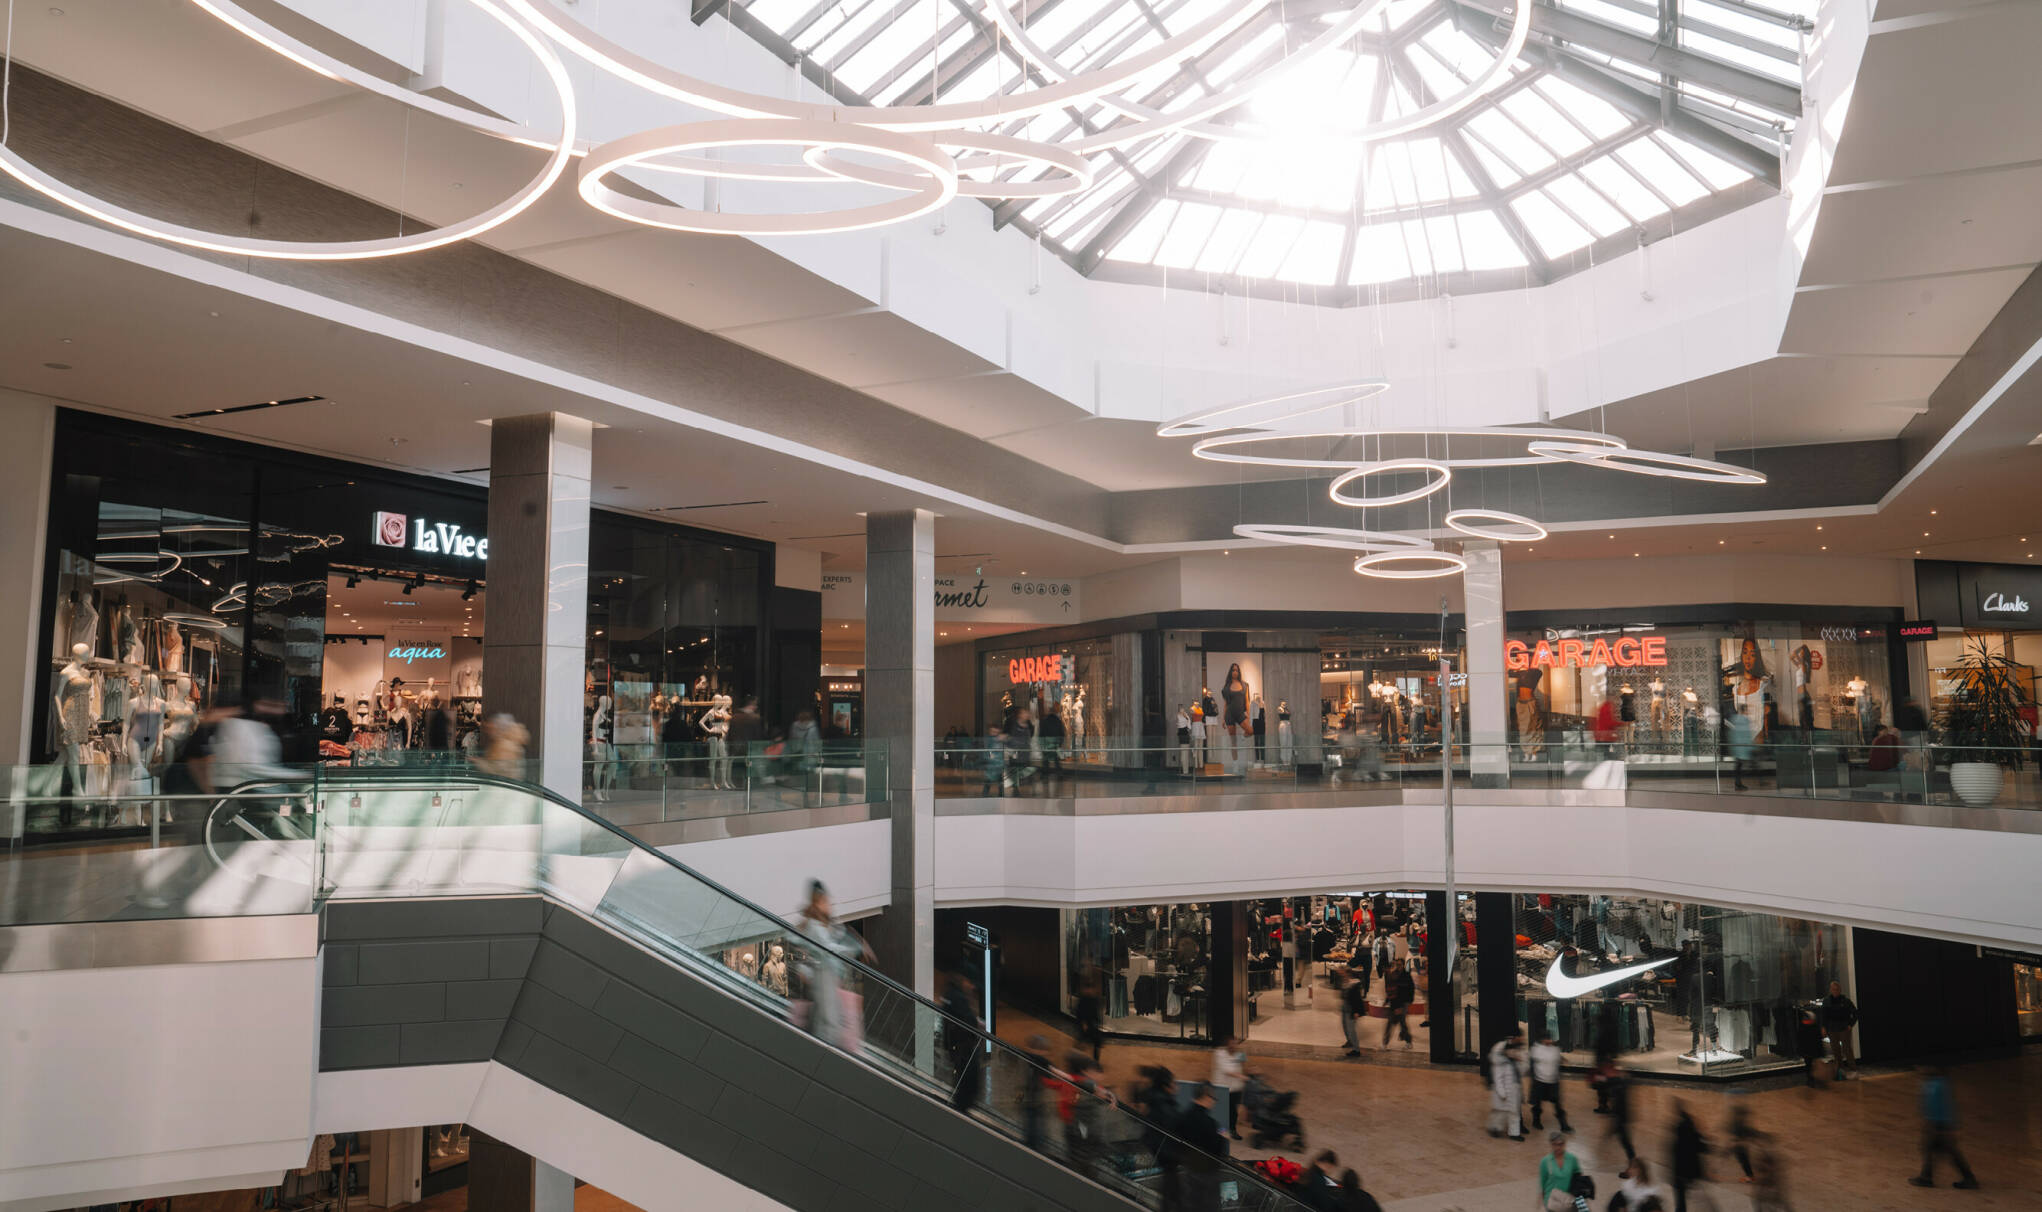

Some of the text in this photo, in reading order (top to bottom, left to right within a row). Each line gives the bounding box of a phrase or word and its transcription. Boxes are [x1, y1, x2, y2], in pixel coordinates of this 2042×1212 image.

[476, 538, 489, 560] e
[822, 575, 852, 583] EXPERTS
[934, 579, 955, 587] PACE
[934, 578, 989, 608] rmet
[1983, 592, 2030, 612] Clarks
[1899, 626, 1933, 636] GARAGE
[388, 647, 447, 665] aqua
[1504, 636, 1668, 671] GARAGE
[1009, 654, 1061, 684] GARAGE
